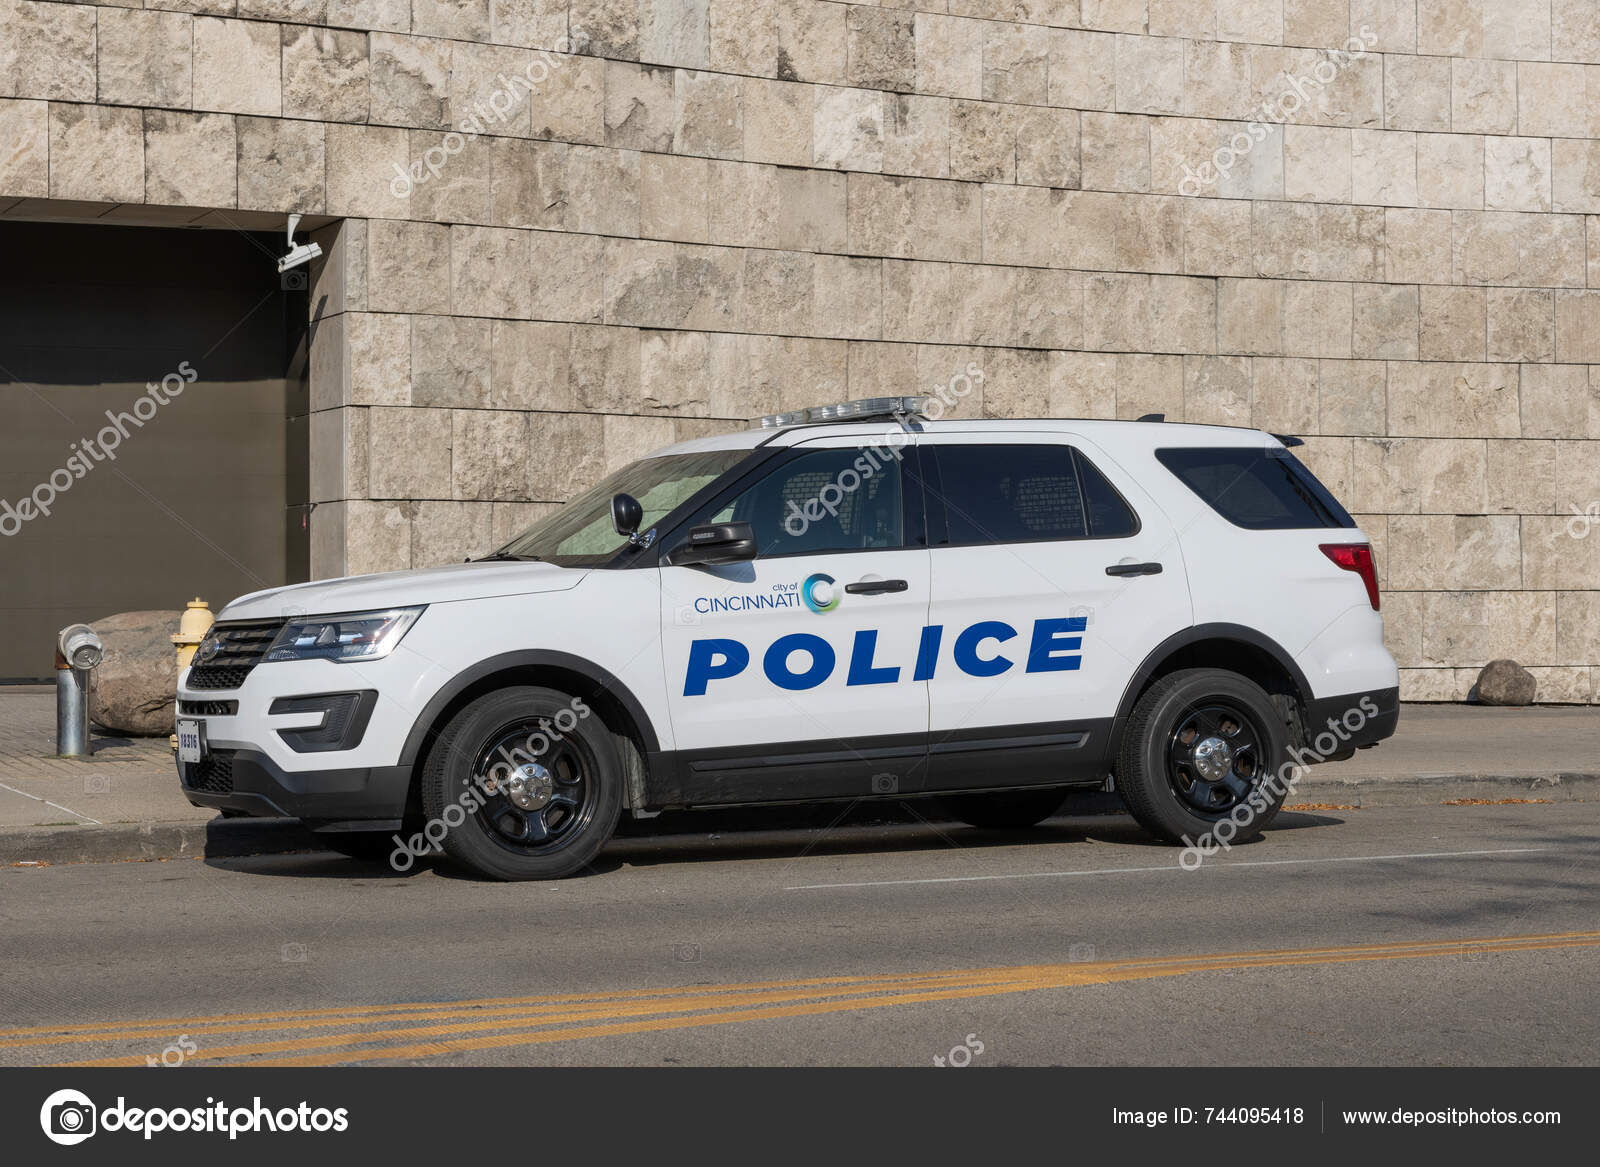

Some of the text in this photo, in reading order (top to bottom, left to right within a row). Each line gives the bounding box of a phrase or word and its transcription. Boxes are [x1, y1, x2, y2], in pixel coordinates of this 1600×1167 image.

[772, 582, 798, 592] city of
[694, 592, 800, 614] CINCINNATI
[683, 616, 1088, 697] POLICE
